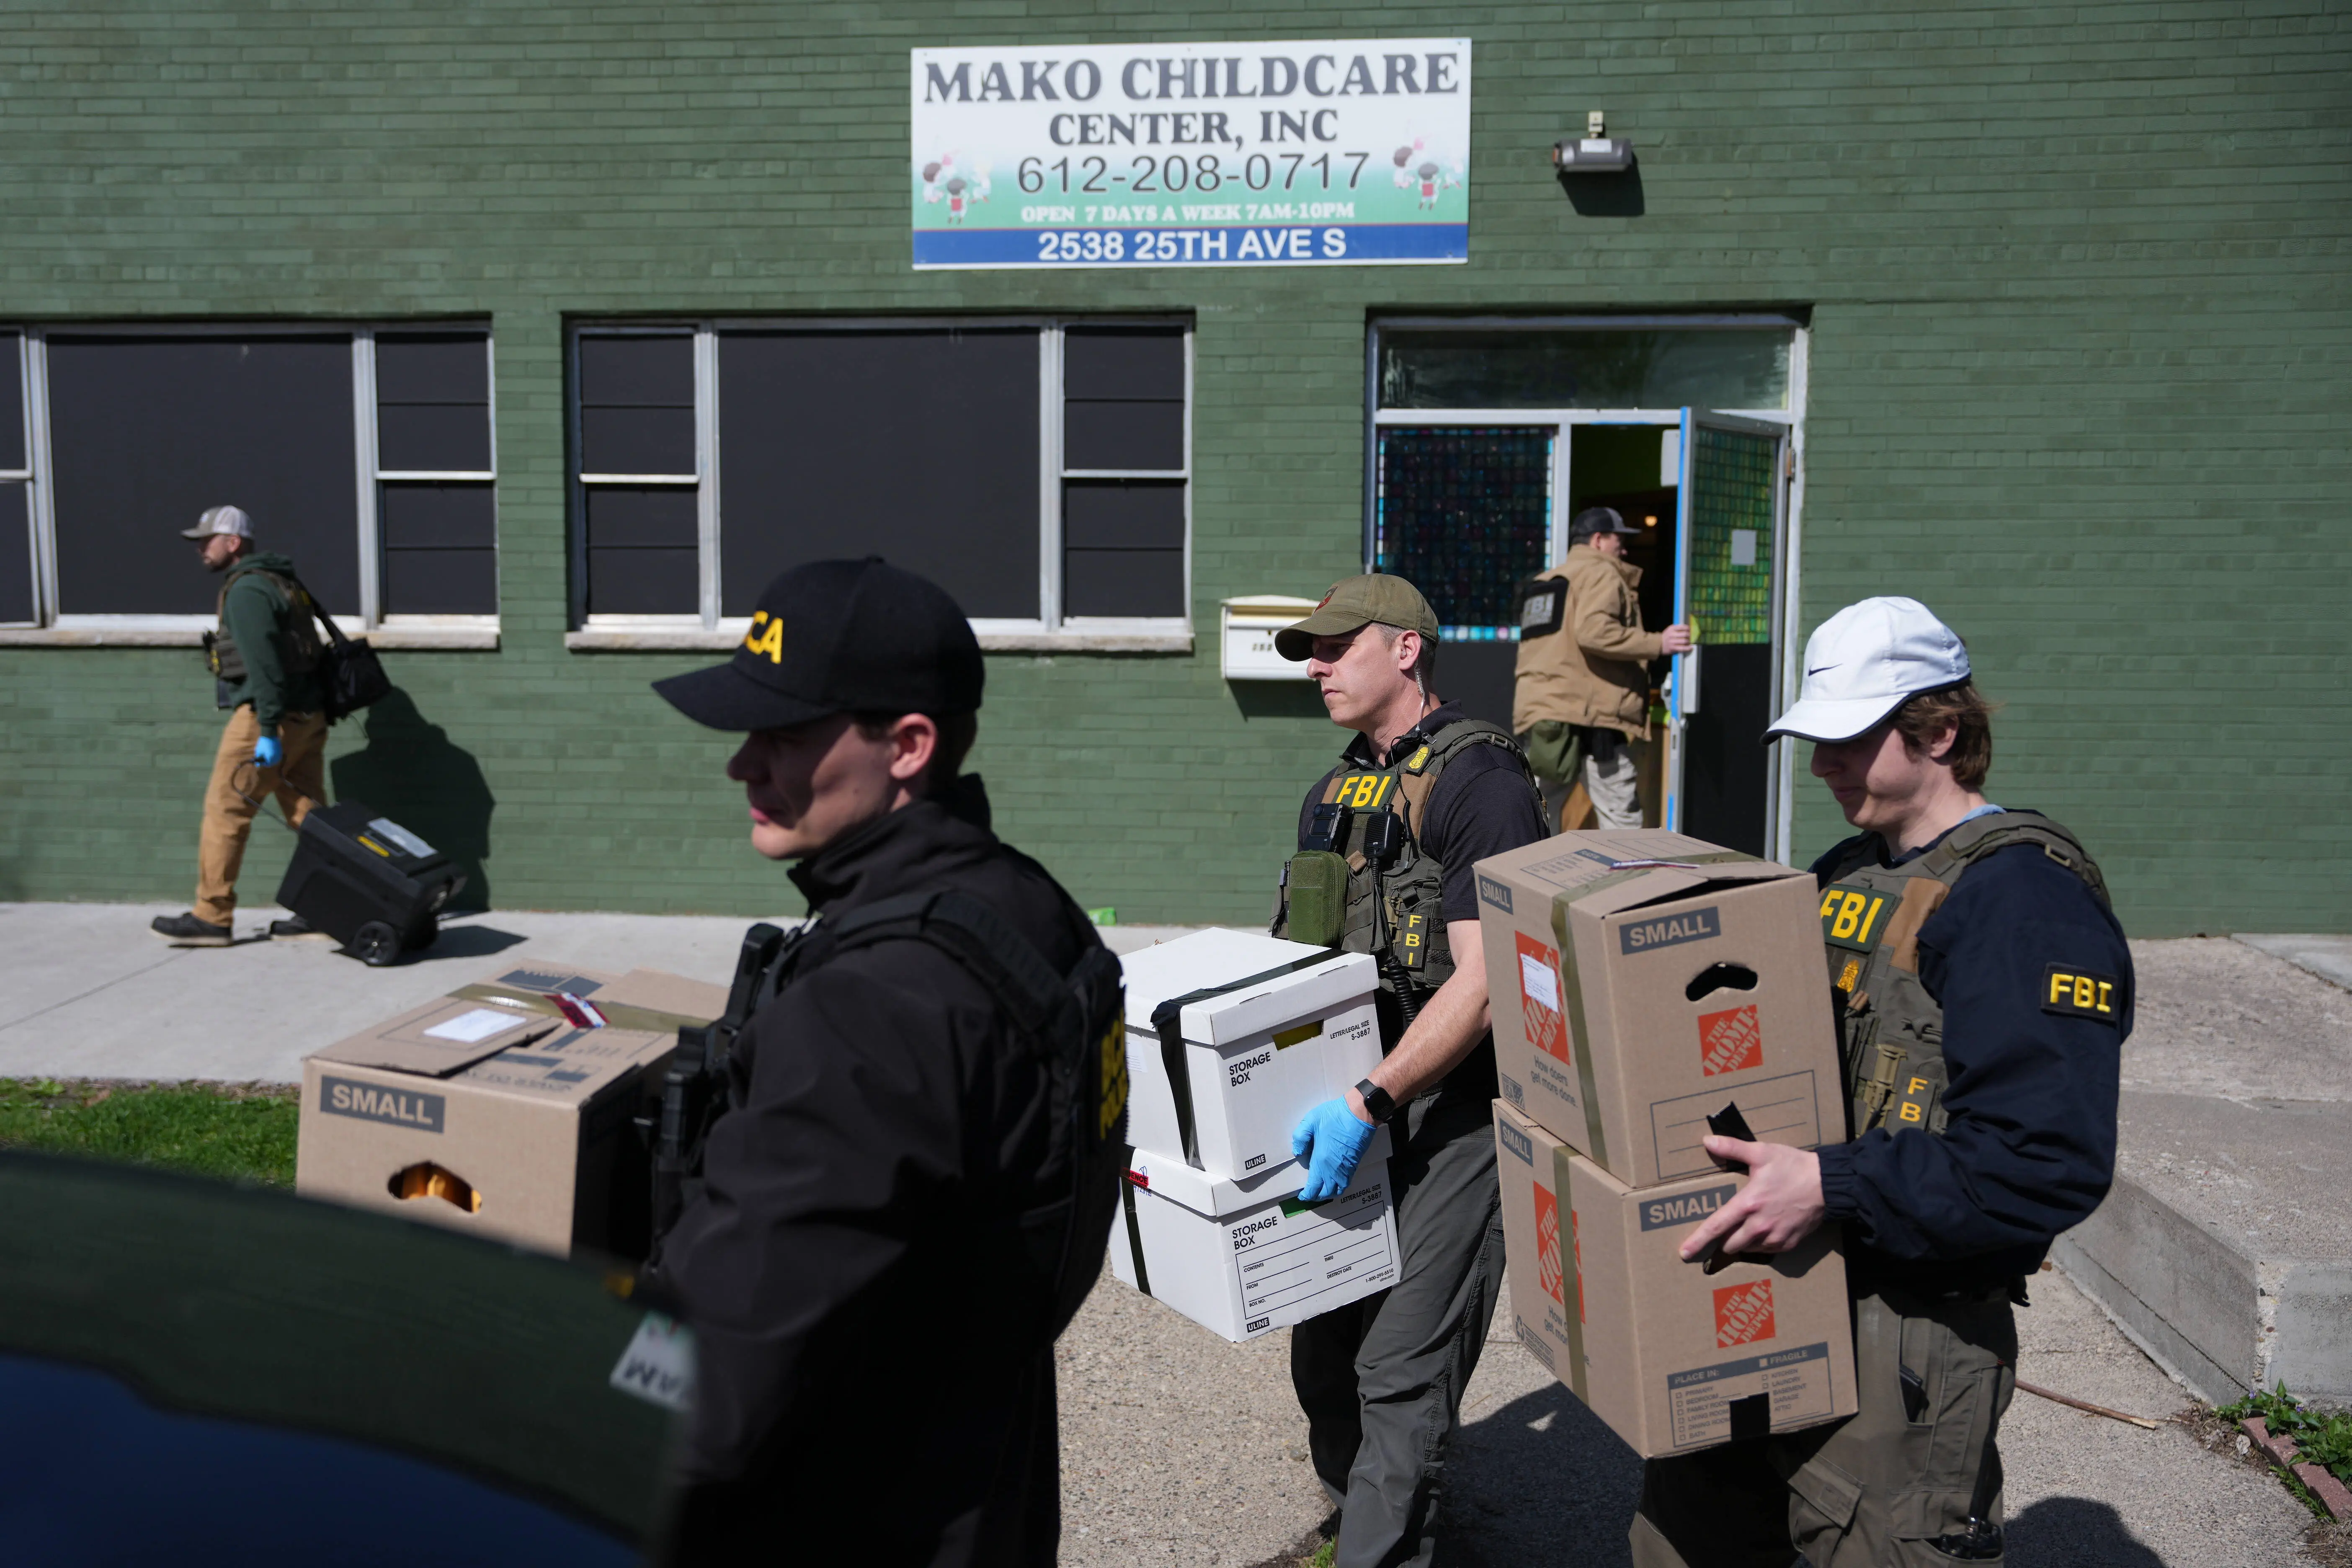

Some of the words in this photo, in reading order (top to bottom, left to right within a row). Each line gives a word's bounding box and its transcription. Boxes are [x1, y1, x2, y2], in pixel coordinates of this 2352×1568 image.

[924, 59, 1101, 102] MAKO
[1122, 53, 1458, 101] CHILDCARE
[1050, 112, 1243, 151] CENTER,
[1260, 110, 1338, 142] INC
[1017, 152, 1370, 193] 612-208-0717
[1021, 205, 1075, 222] OPEN
[1085, 206, 1098, 221] 7
[1102, 204, 1158, 222] DAYS
[1162, 205, 1177, 222] A
[1181, 204, 1241, 221] WEEK
[1246, 202, 1355, 220] 7AM-10PM
[1038, 231, 1124, 261] 2538
[1134, 230, 1227, 260] 25TH
[1237, 229, 1312, 258] AVE
[1323, 228, 1347, 258] S
[745, 610, 783, 665] CA
[1336, 776, 1391, 807] FBI
[1483, 881, 1510, 907] SMALL
[1820, 890, 1884, 944] FBI
[1405, 915, 1422, 965] FBI
[1629, 916, 1712, 948] SMALL
[2050, 972, 2113, 1014] FBI
[1330, 1024, 1360, 1039] LETTER/LEGAL
[1361, 1020, 1369, 1029] SIZE
[1351, 1028, 1370, 1040] S-3887
[1703, 1004, 1760, 1074] HOME
[1706, 1017, 1730, 1044] THE
[1727, 1028, 1759, 1070] DEPOT
[1229, 1052, 1271, 1075] STORAGE
[1534, 1055, 1548, 1074] How
[1231, 1072, 1251, 1087] BOX
[1542, 1078, 1558, 1095] more
[331, 1086, 433, 1125] SMALL
[1899, 1077, 1928, 1122] FB
[1502, 1125, 1530, 1161] SMALL
[1246, 1155, 1265, 1168] ULINE
[1341, 1188, 1371, 1204] LETTER/LEGAL
[1372, 1184, 1381, 1193] SIZE
[1362, 1191, 1382, 1204] S-3887
[1232, 1216, 1277, 1239] STORAGE
[1540, 1204, 1556, 1241] THE
[1234, 1235, 1256, 1250] BOX
[1244, 1263, 1264, 1273] CONTENTS
[1327, 1270, 1343, 1279] DESTROY
[1343, 1266, 1352, 1274] DATE
[1365, 1269, 1394, 1283] 1-800-295-5510
[1380, 1274, 1394, 1282] uline.com
[1720, 1291, 1745, 1316] THE
[1549, 1305, 1562, 1327] How
[1717, 1282, 1771, 1346] HOME
[1740, 1301, 1773, 1342] DEPOT
[1248, 1318, 1269, 1331] ULINE
[1770, 1350, 1808, 1364] FRAGILE
[1675, 1371, 1705, 1384] PLACE
[1707, 1369, 1720, 1379] IN:
[1771, 1368, 1799, 1378] KITCHEN
[1772, 1376, 1800, 1387] LAUNDRY
[1685, 1385, 1714, 1396] PRIMARY
[1686, 1393, 1719, 1405] BEDROOM
[1773, 1383, 1808, 1395] BASEMENT
[1774, 1393, 1800, 1403] GARAGE
[1687, 1403, 1708, 1413] FAMILY
[1688, 1412, 1708, 1422] LIVING
[1710, 1408, 1729, 1417] ROOM
[1689, 1421, 1710, 1430] DINING
[1689, 1430, 1706, 1439] BATH
